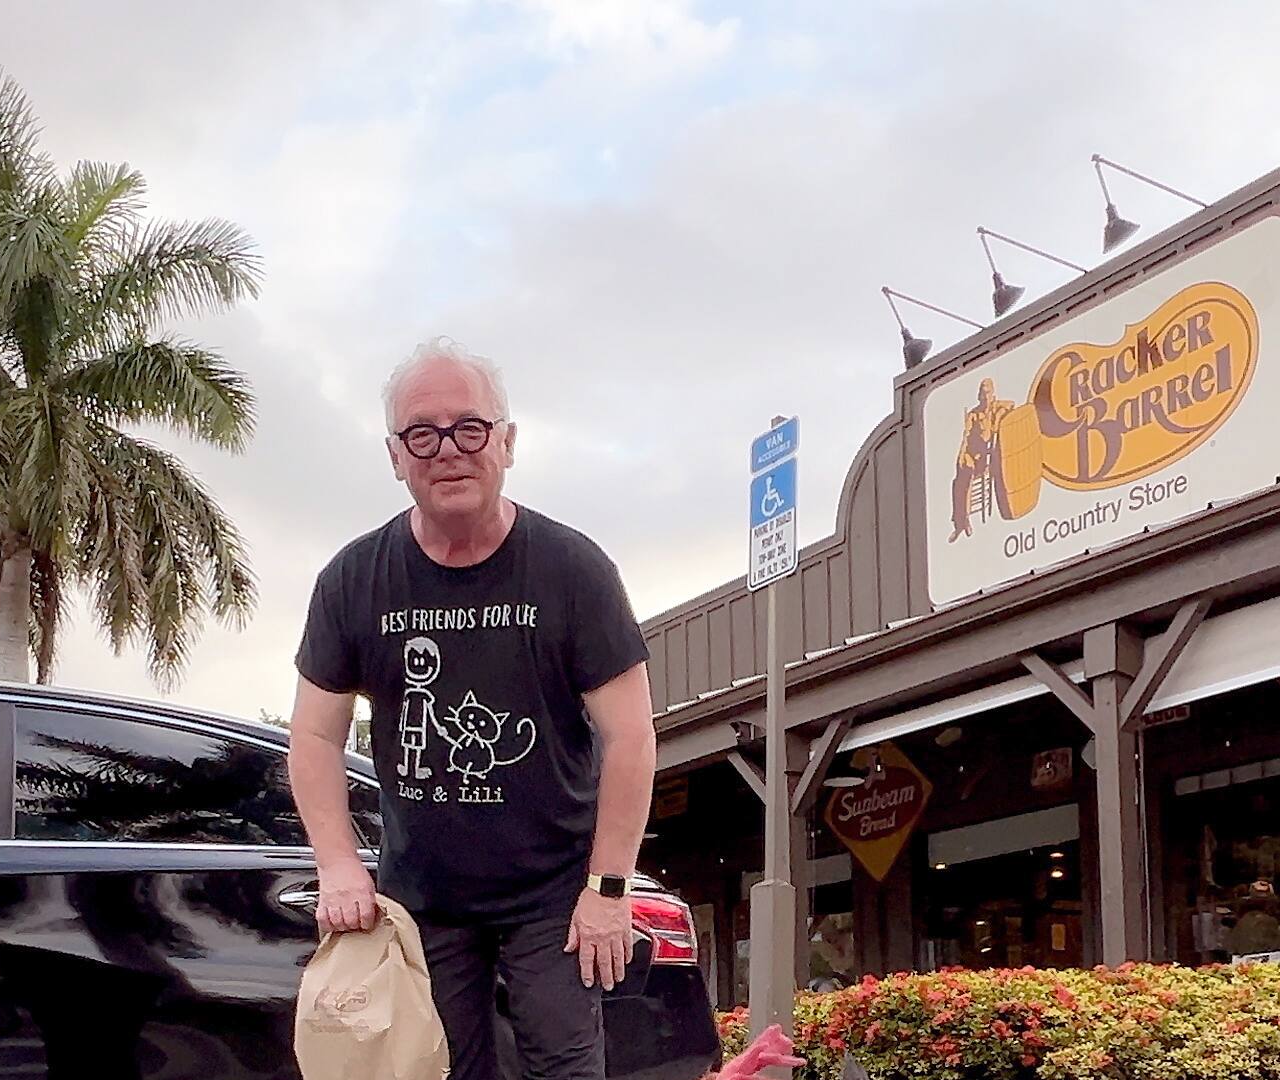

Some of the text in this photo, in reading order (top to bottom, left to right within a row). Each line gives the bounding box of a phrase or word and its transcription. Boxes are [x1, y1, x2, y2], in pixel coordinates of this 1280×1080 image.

[765, 431, 784, 450] VAN
[1003, 474, 1188, 558] Old Country Store
[412, 607, 477, 632] FRIENDS
[481, 603, 512, 628] FOR
[398, 781, 504, 803] Luc & Lili
[838, 785, 915, 822] Sunbeam
[859, 809, 897, 837] Bread
